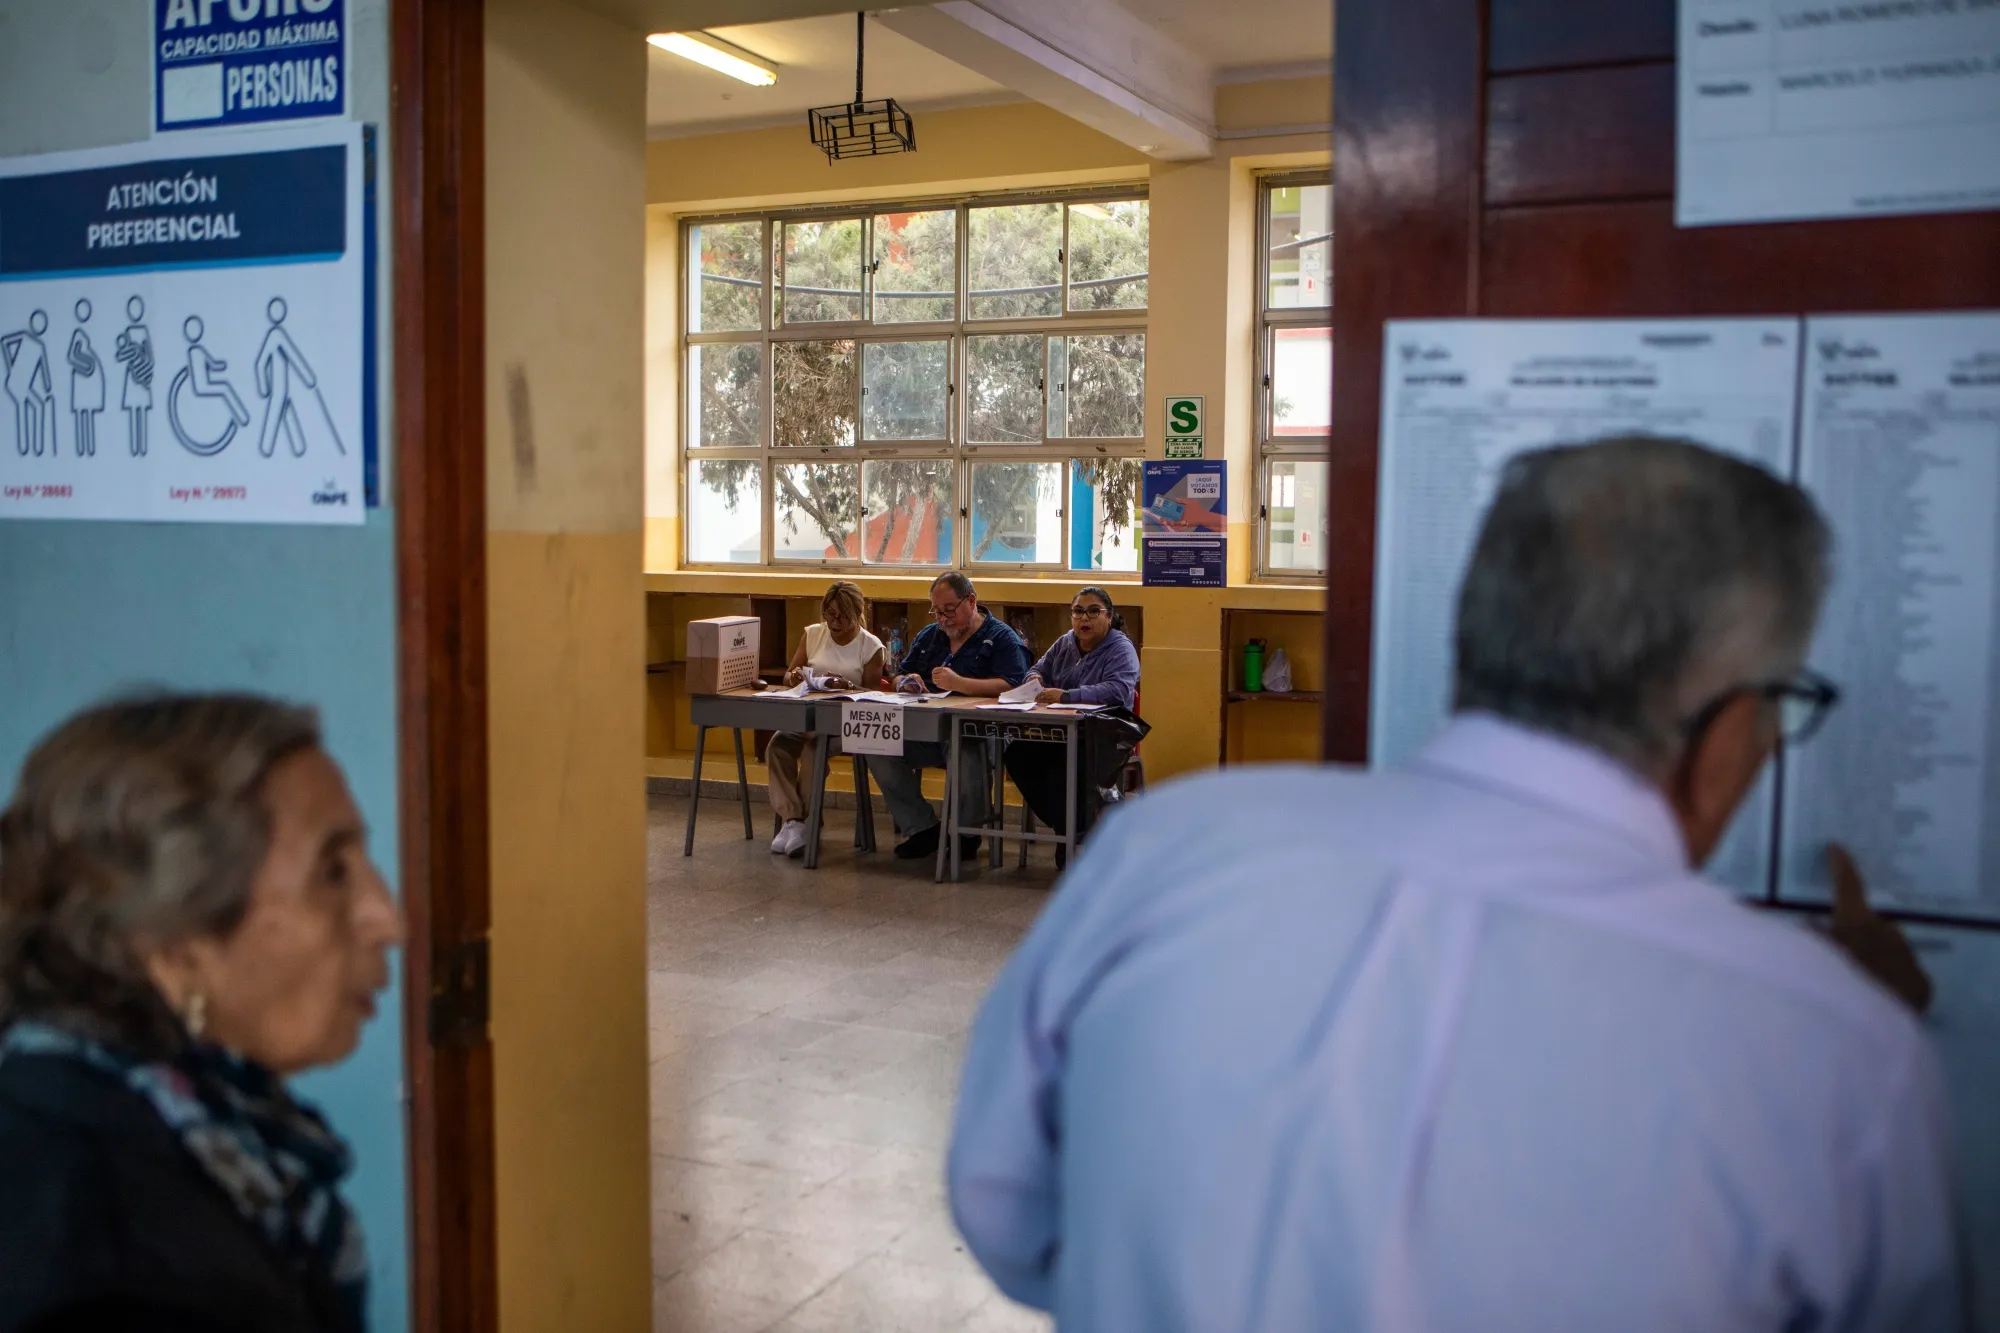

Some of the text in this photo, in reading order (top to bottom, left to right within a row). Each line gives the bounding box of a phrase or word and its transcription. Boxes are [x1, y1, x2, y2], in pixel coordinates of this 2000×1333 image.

[161, 20, 338, 59] CAPACIDAD MÁXIMA
[227, 56, 338, 111] PERSONAS
[106, 171, 218, 211] ATENCIÓN
[87, 213, 241, 250] PREFERENCIAL
[1170, 401, 1198, 433] S
[4, 484, 21, 501] Ley
[170, 486, 190, 503] Ley
[733, 636, 746, 647] ONPE
[849, 710, 881, 722] MESA
[843, 722, 901, 741] 047768
